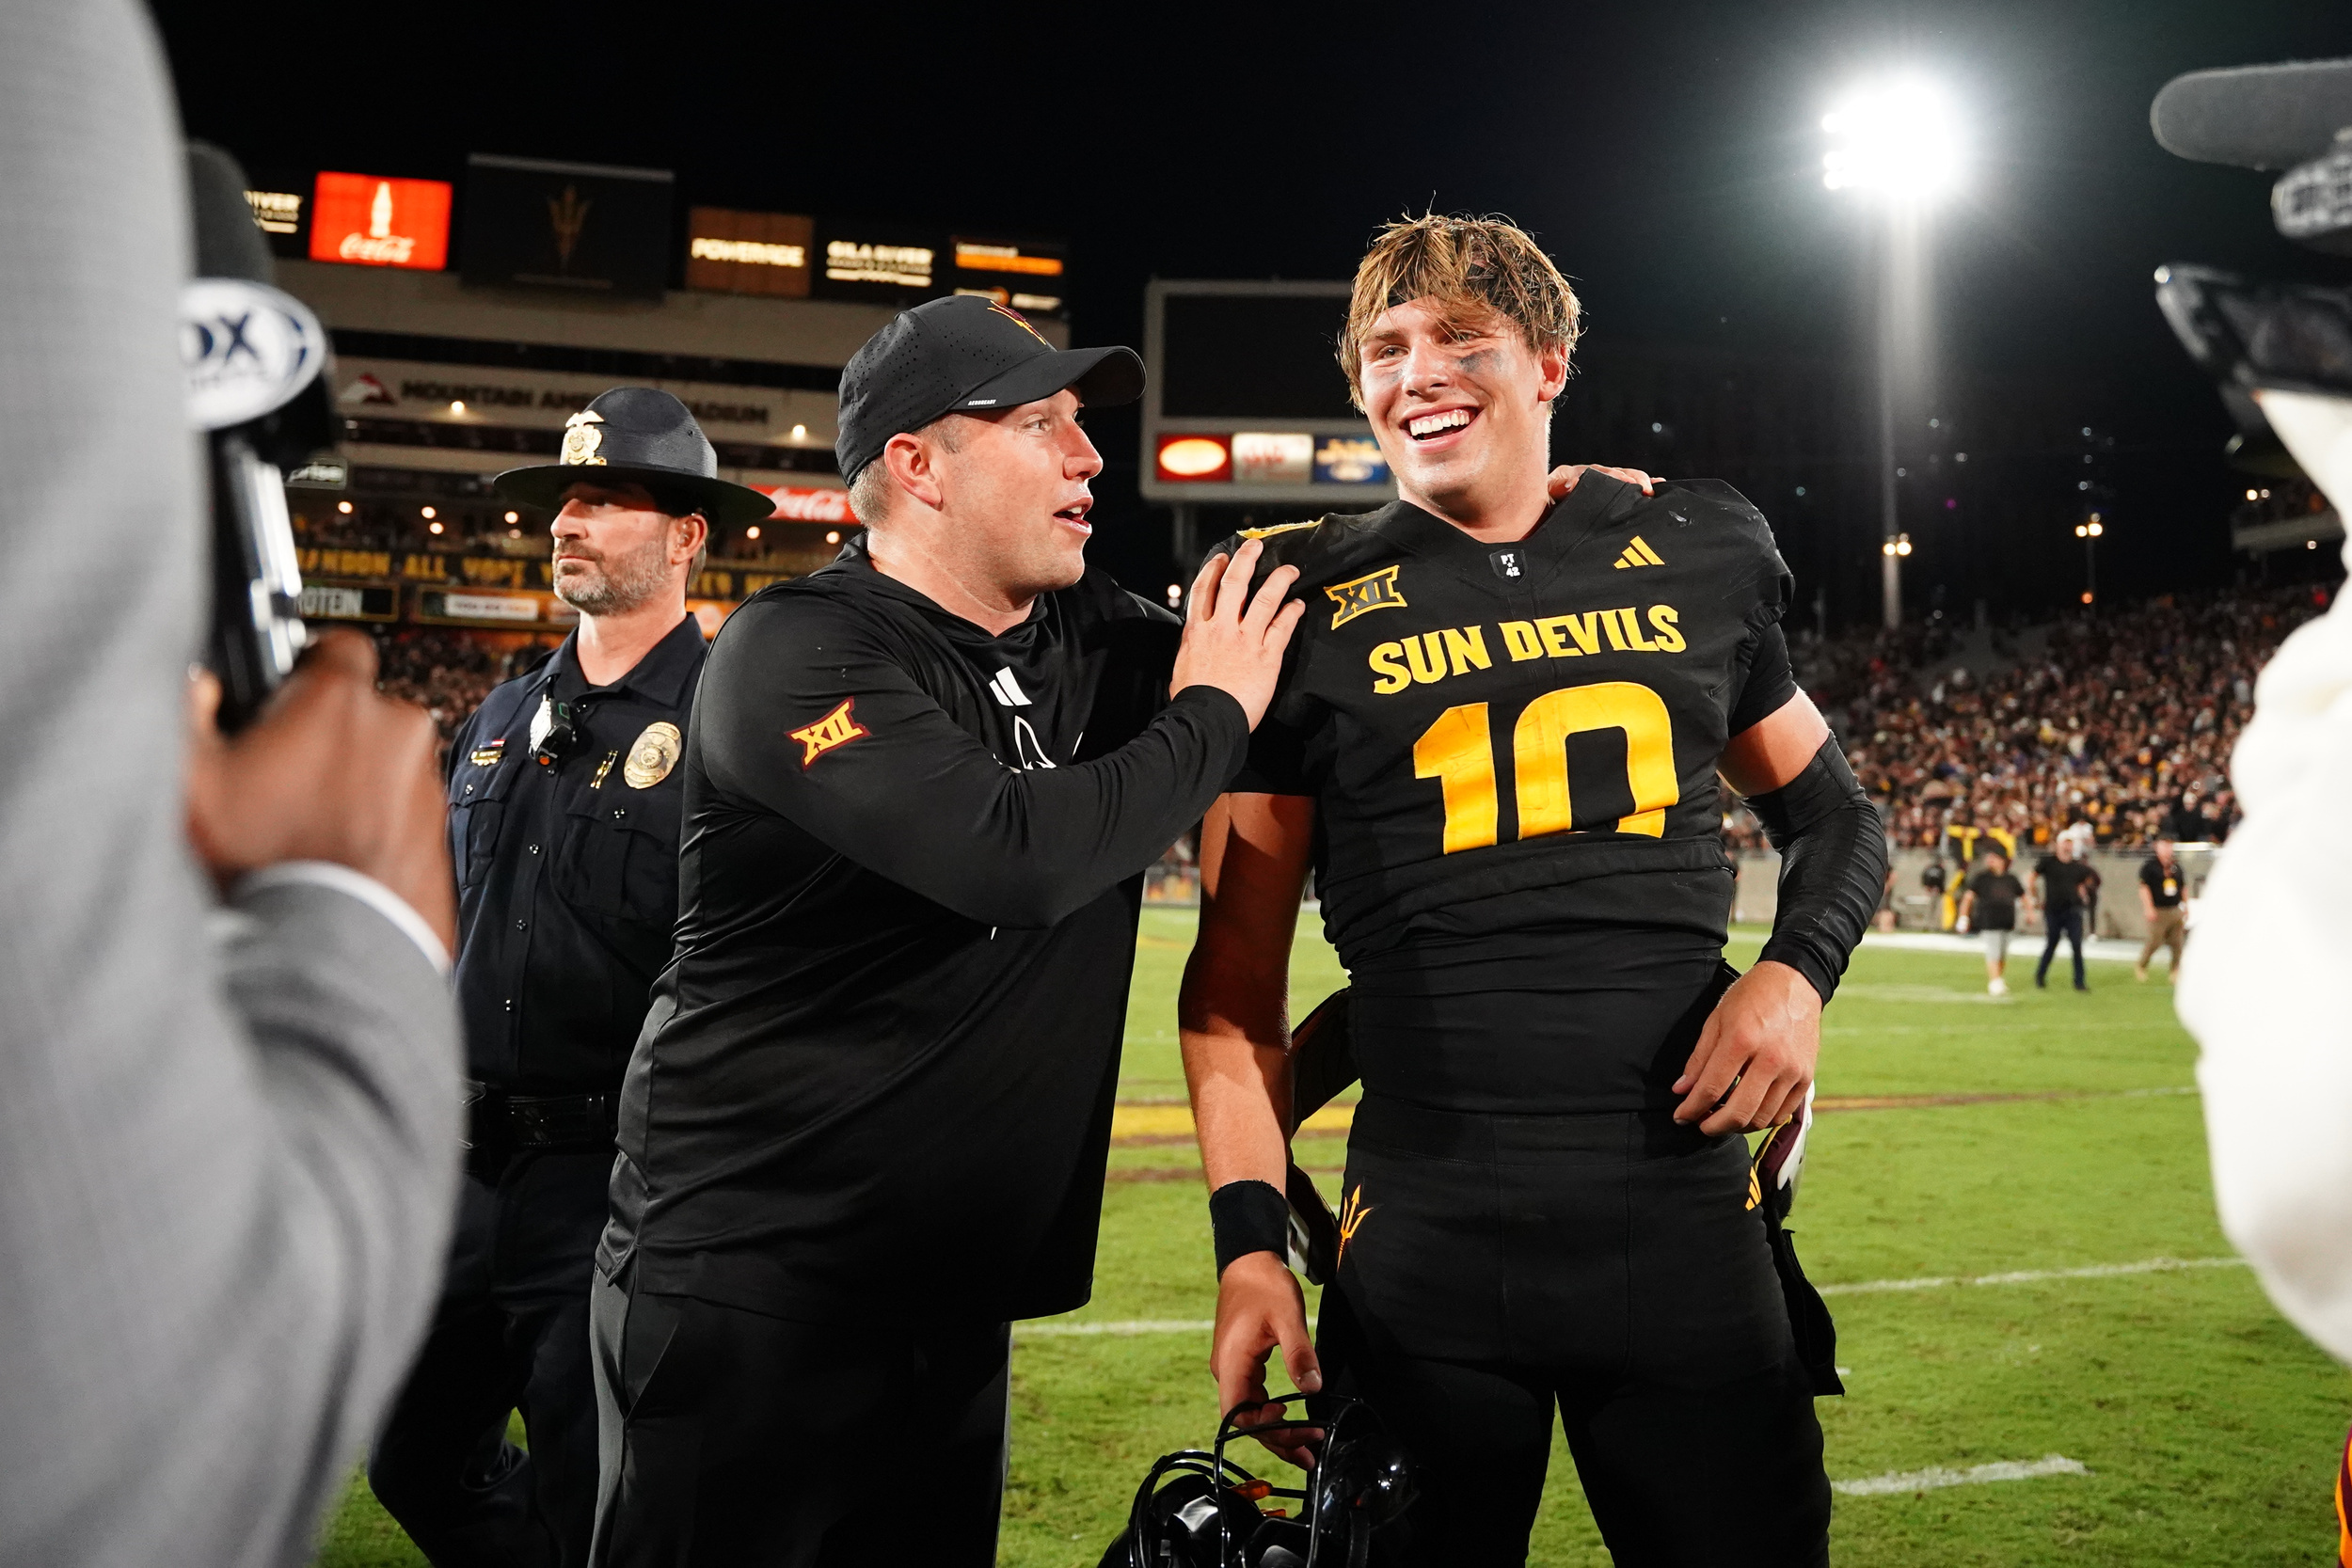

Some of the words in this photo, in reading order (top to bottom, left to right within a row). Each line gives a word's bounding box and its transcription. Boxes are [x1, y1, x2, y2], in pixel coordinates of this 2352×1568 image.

[189, 311, 261, 364] OX
[1500, 553, 1515, 565] PT
[1506, 566, 1520, 578] 42
[1326, 566, 1405, 628] XII
[1369, 625, 1493, 695] SUN
[1498, 604, 1687, 662] DEVILS
[787, 699, 866, 768] XII
[1413, 681, 1679, 855] 10
